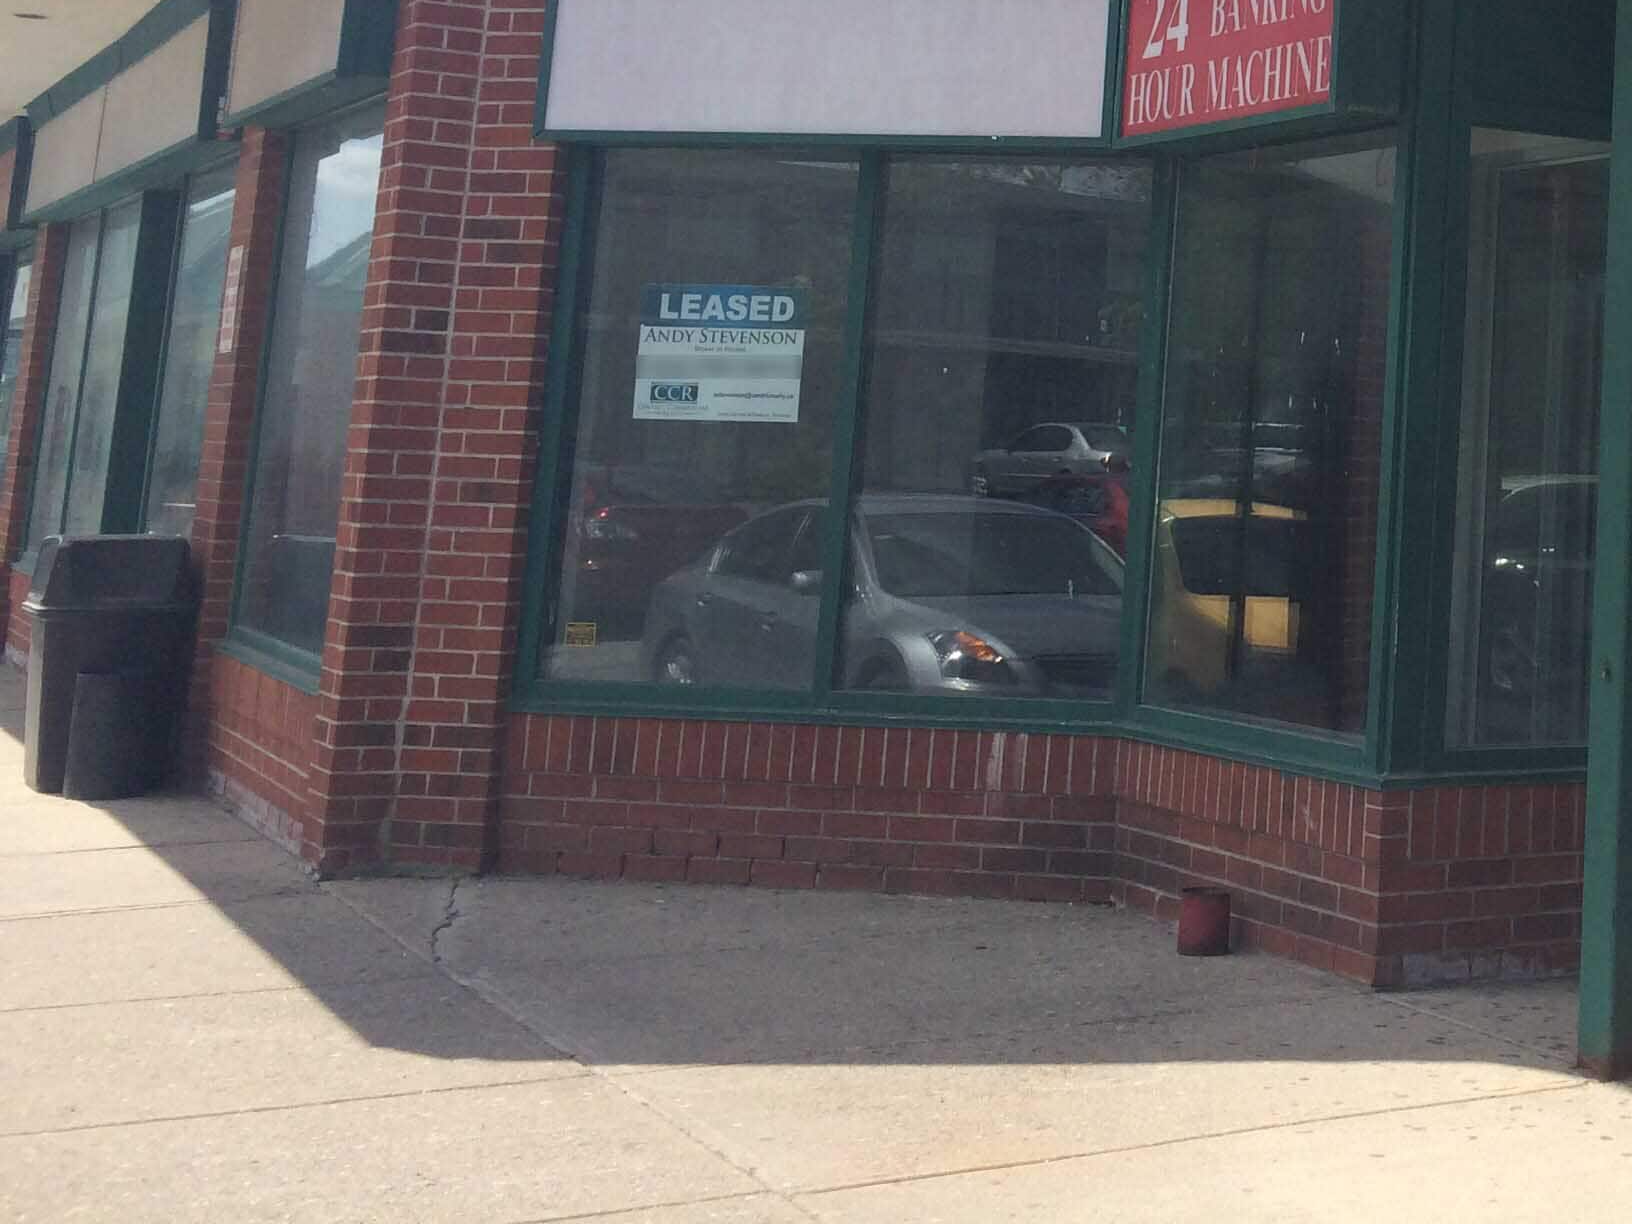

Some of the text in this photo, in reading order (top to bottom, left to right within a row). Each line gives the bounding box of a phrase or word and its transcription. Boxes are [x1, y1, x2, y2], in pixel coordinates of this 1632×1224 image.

[1127, 35, 1332, 126] HOUR MACHINE
[659, 293, 795, 322] LEASED
[643, 328, 797, 345] ANDY STEVENSON
[653, 386, 693, 402] CCR
